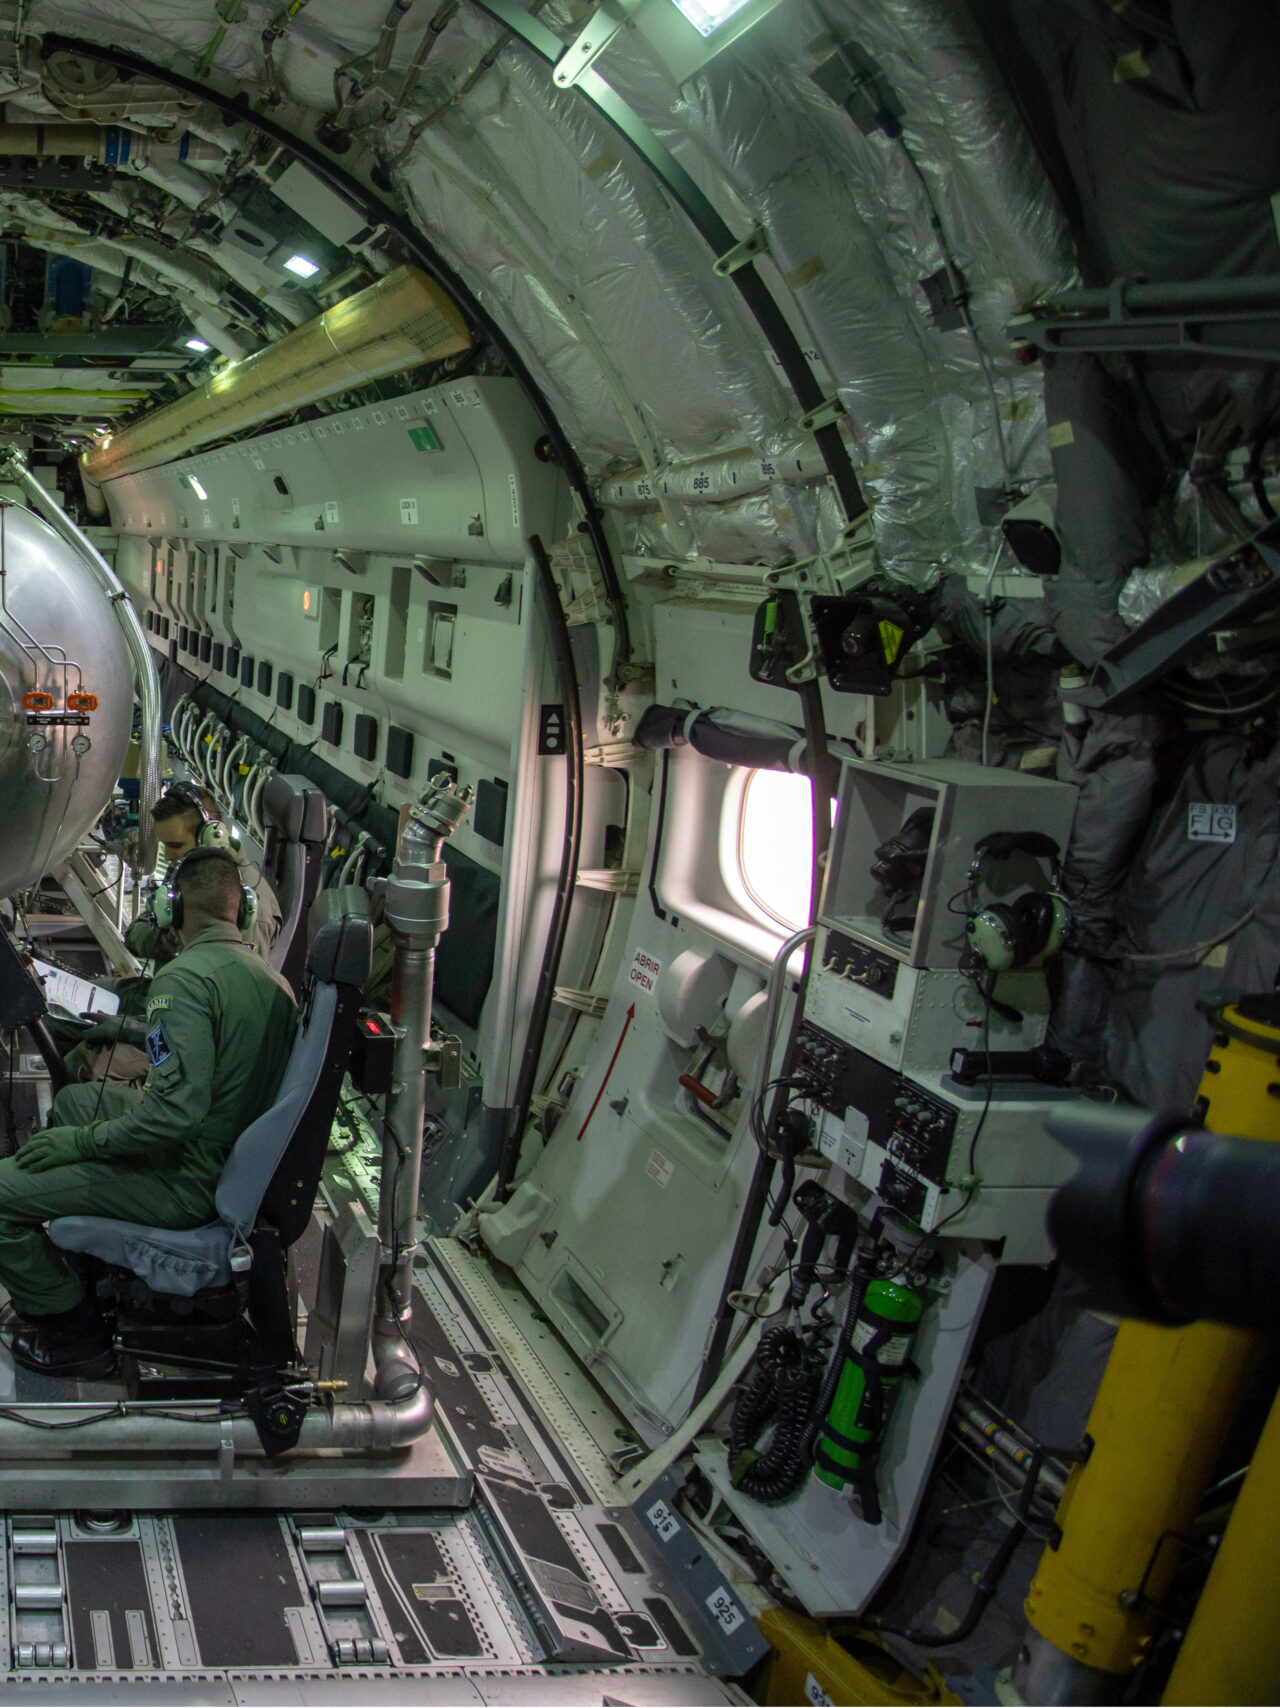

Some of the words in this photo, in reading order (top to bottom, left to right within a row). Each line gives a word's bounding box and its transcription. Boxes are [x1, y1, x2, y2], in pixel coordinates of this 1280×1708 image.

[761, 463, 776, 475] 895
[637, 485, 651, 496] 875
[693, 478, 710, 490] 885
[1190, 803, 1208, 814] FS
[1211, 805, 1234, 815] 930
[1191, 814, 1203, 828] F
[1217, 816, 1233, 829] G
[634, 952, 660, 976] ABRIR
[630, 968, 654, 991] OPEN
[653, 1508, 673, 1533] 915
[713, 1597, 736, 1625] 925
